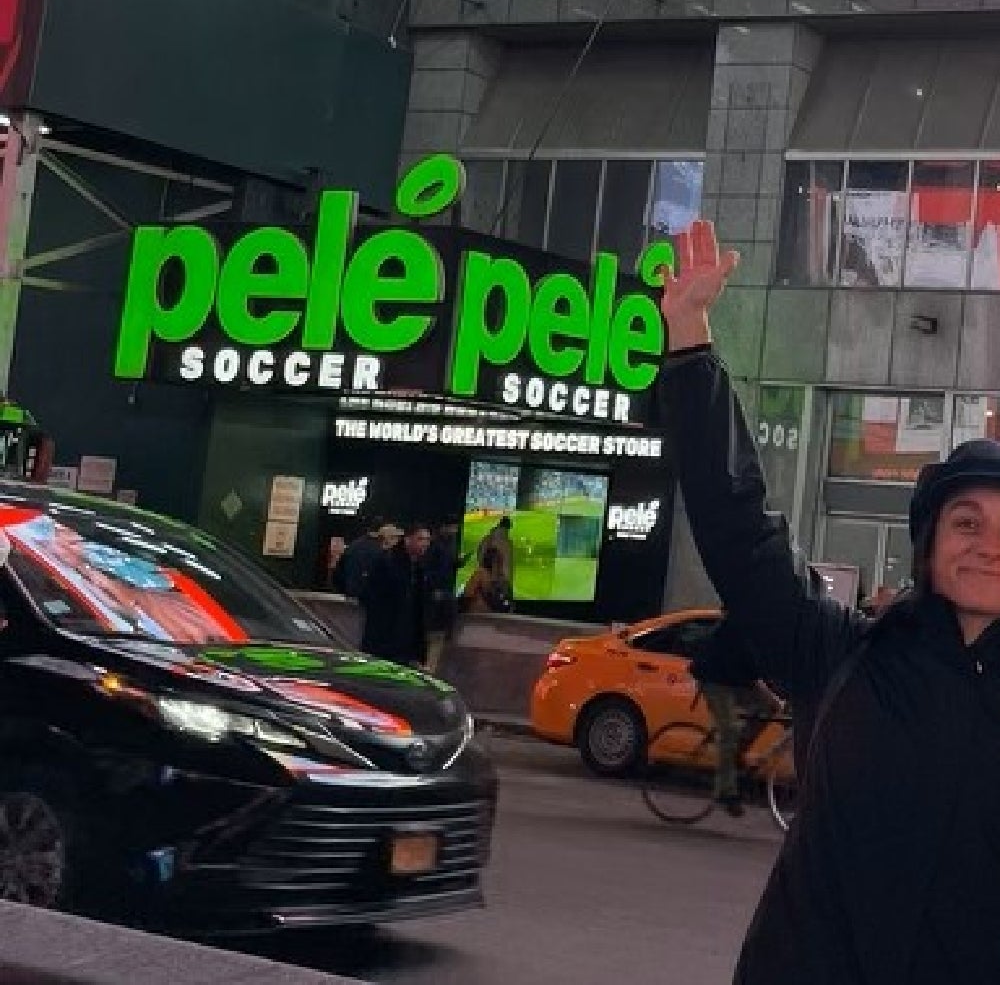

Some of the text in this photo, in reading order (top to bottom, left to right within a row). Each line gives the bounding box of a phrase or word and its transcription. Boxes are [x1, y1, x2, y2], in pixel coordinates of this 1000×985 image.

[114, 153, 466, 378] pelé
[179, 346, 381, 390] SOCCER
[501, 372, 632, 423] SOCCER
[335, 419, 662, 457] THE WORLD'S GREATEST SOCCER STORE
